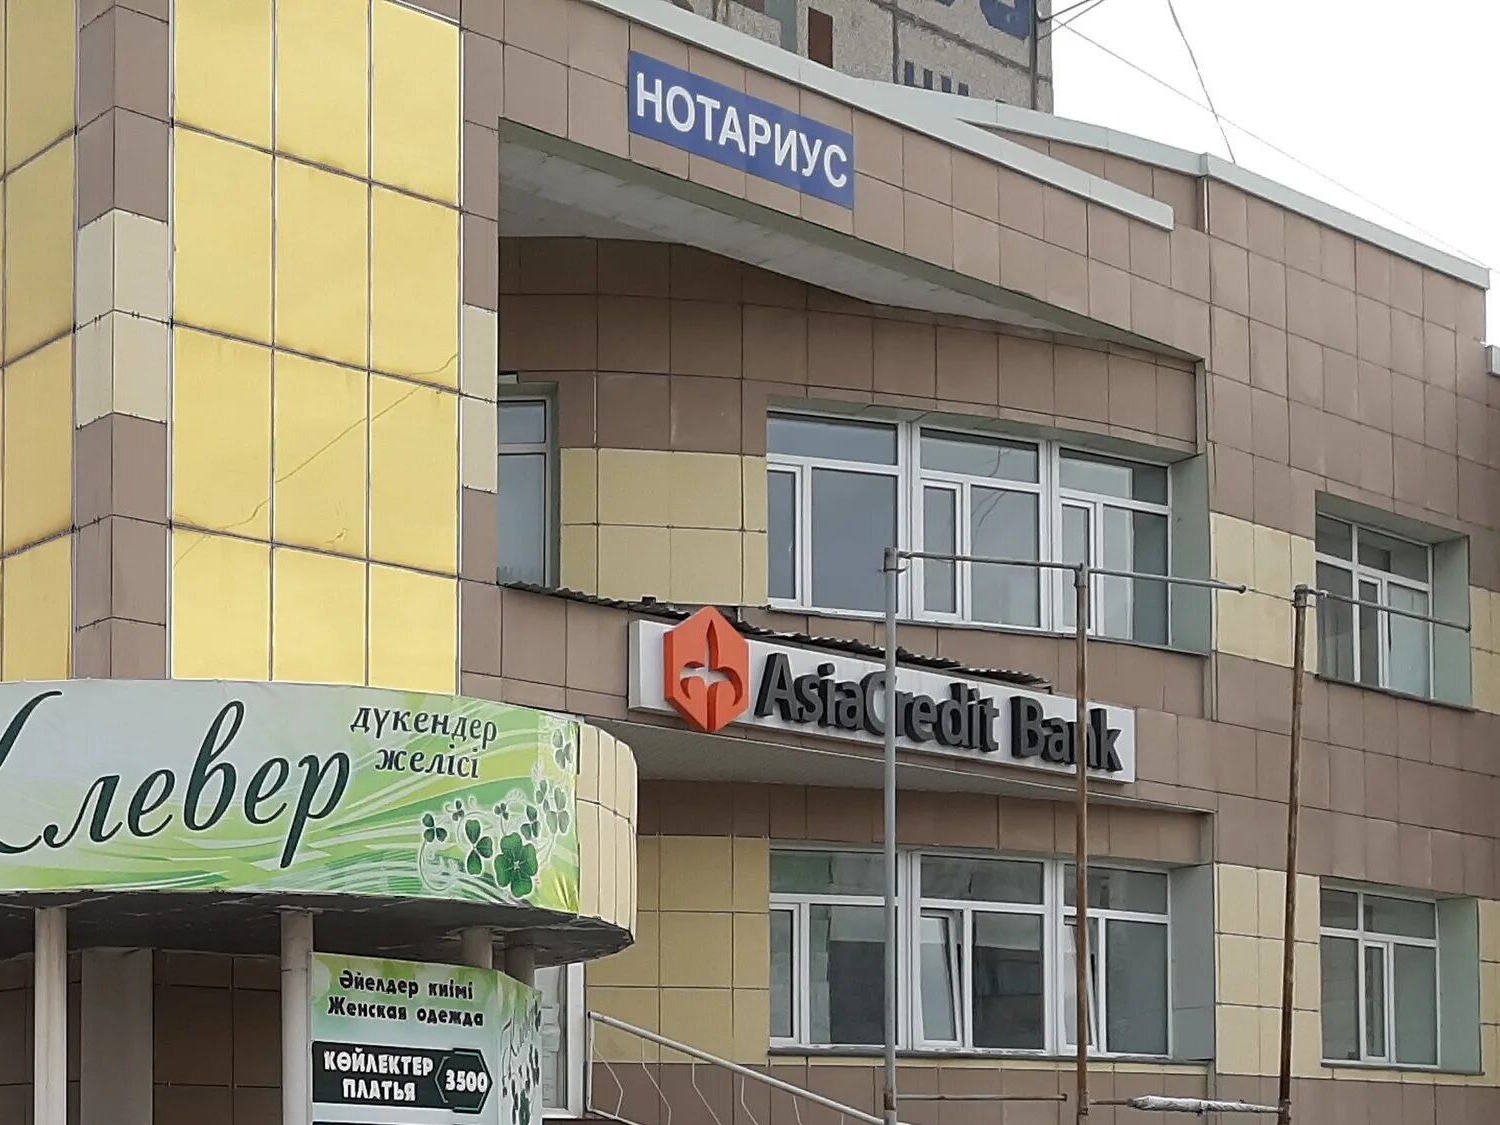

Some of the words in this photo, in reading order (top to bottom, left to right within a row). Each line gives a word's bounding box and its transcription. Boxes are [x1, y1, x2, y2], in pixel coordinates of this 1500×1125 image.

[636, 72, 848, 188] НОТАРИУС
[754, 652, 1000, 753] AsiaCredit
[350, 705, 498, 744] дүкендер
[374, 741, 480, 779] желісі
[338, 970, 419, 999] Әйелдер
[428, 979, 474, 1000] киімі
[327, 996, 407, 1021] Женская
[416, 1007, 484, 1027] одежда
[323, 1047, 434, 1077] КӨЙЛЕКТЕР
[342, 1079, 416, 1102] ПЛАТЬЯ
[445, 1069, 488, 1093] 3500
